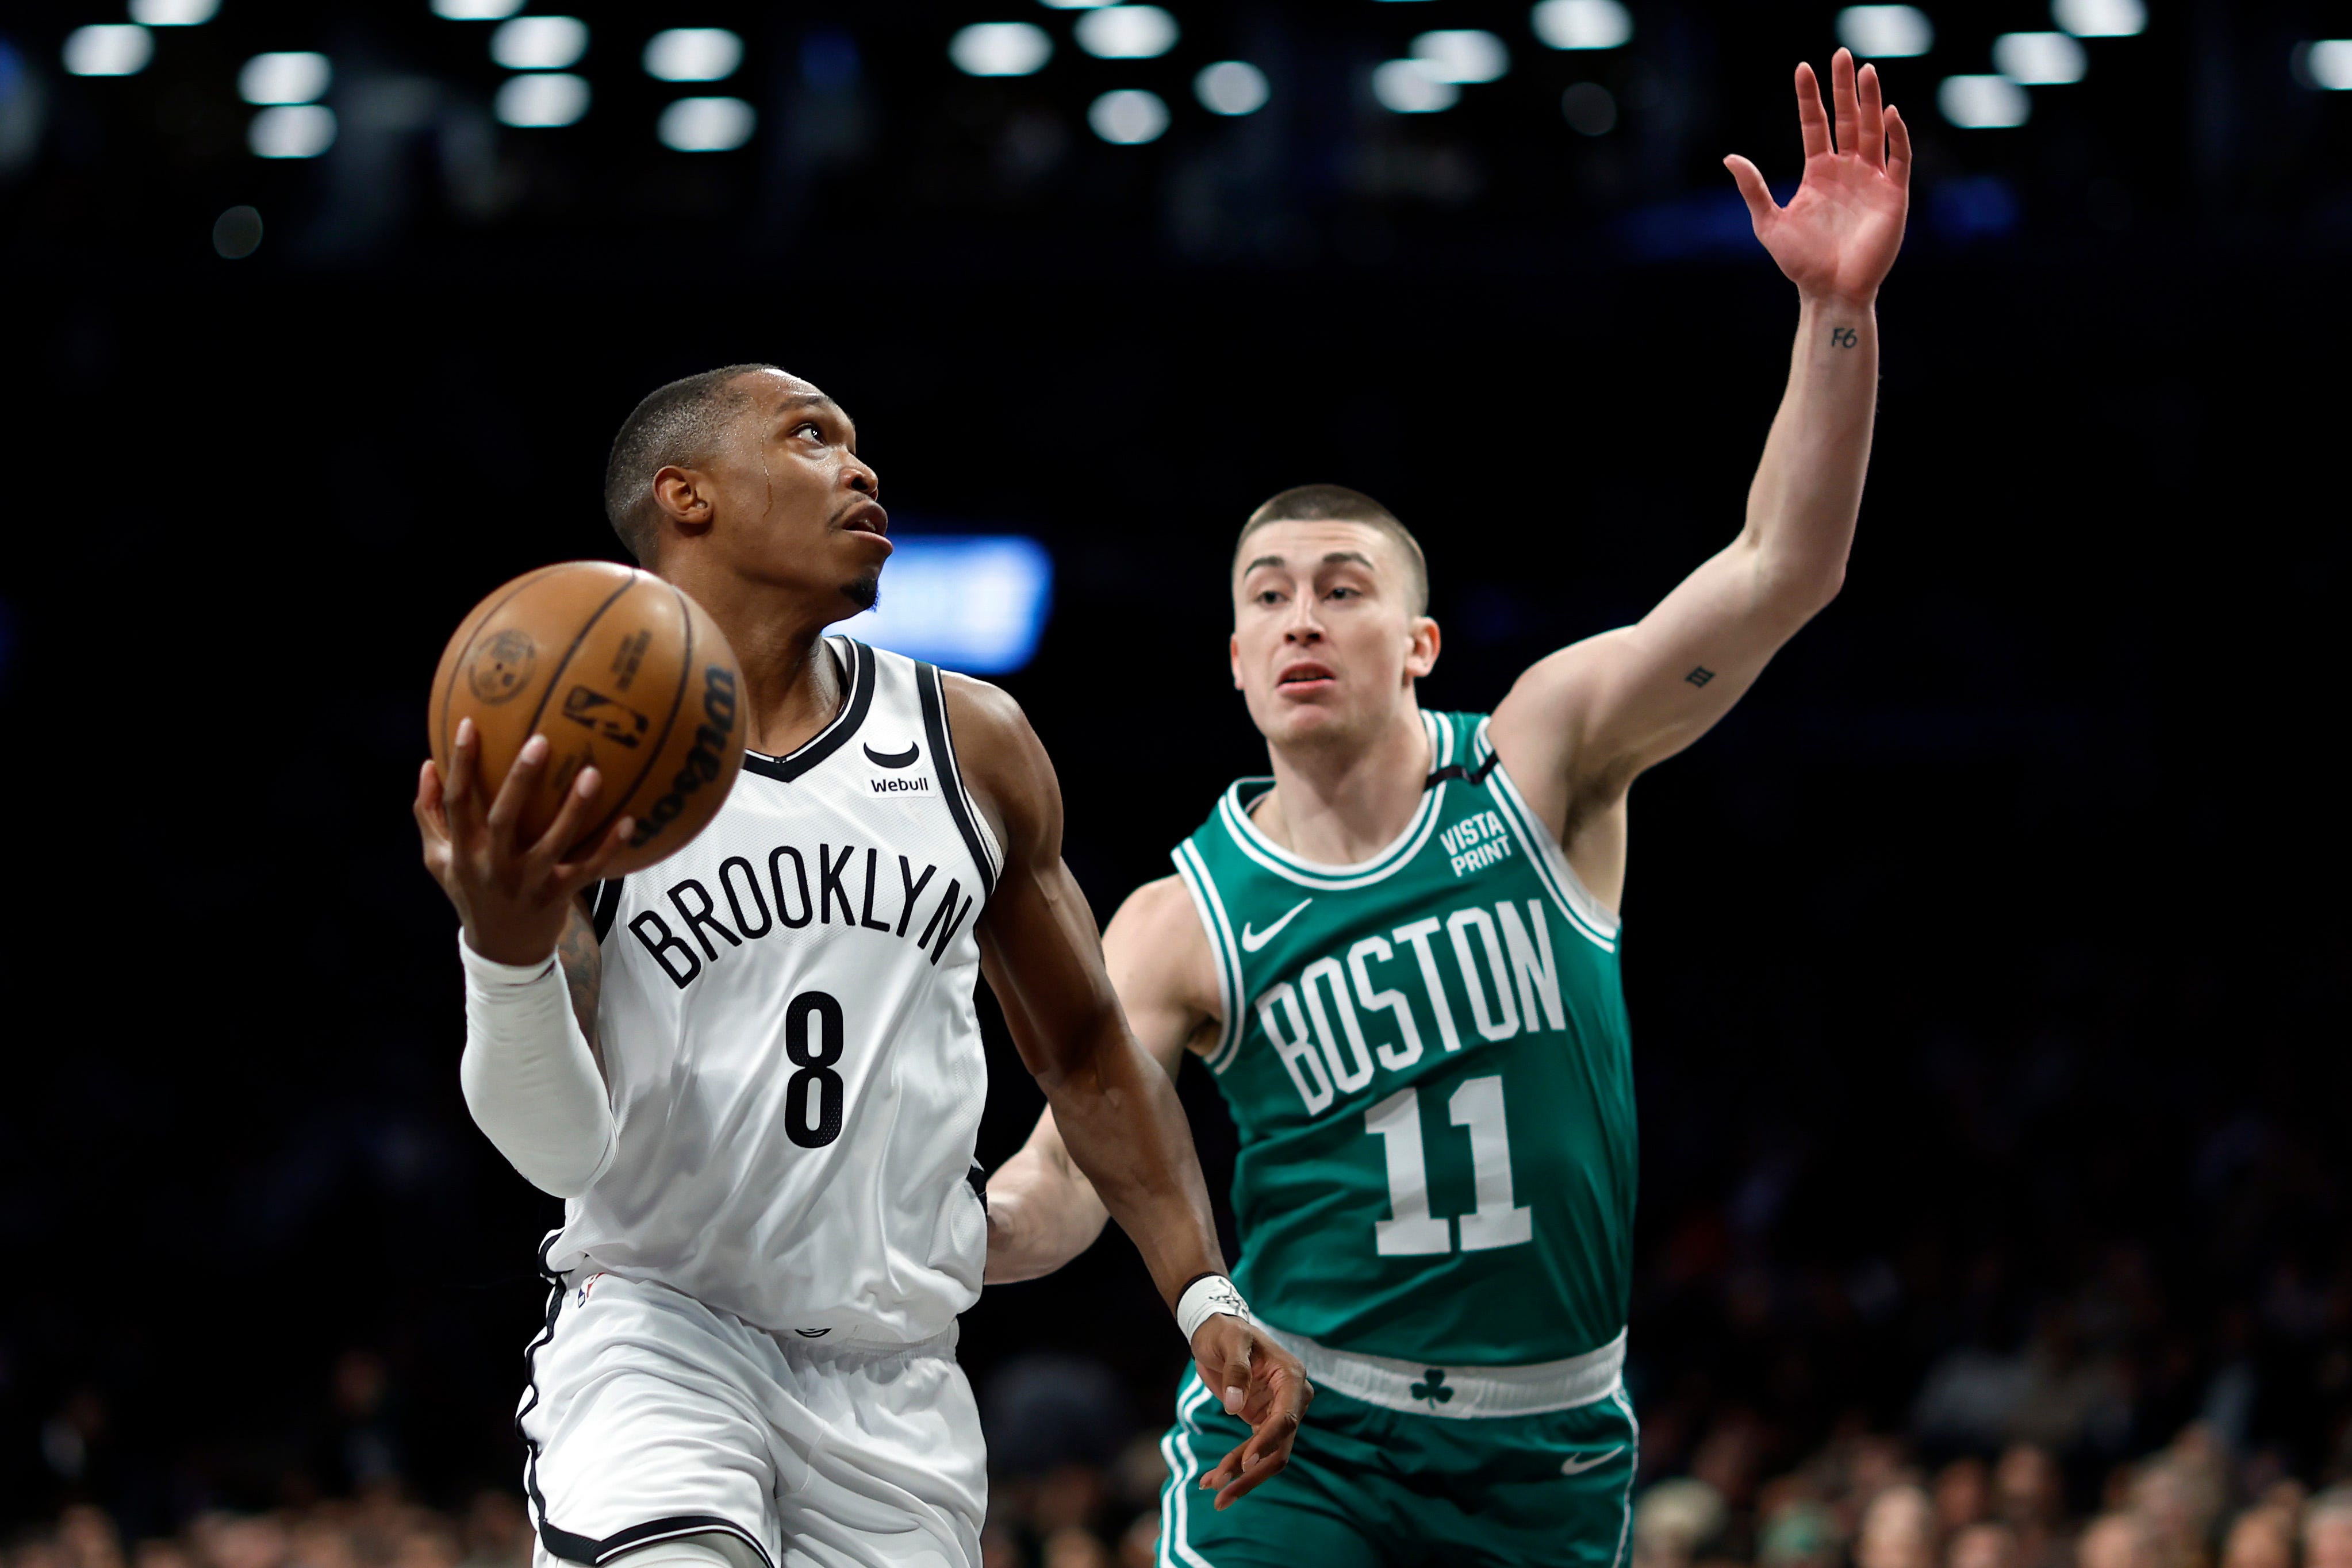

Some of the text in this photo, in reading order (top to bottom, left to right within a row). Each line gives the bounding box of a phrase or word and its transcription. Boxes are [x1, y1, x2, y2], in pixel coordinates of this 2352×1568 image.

[1831, 327, 1858, 348] F6
[870, 777, 929, 793] Webull
[1439, 810, 1506, 856] VISTA
[1451, 835, 1512, 878] PRINT
[627, 843, 973, 990] BROOKLYN
[1254, 898, 1566, 1116] BOSTON
[784, 990, 844, 1149] 8
[1364, 1074, 1533, 1256] 11
